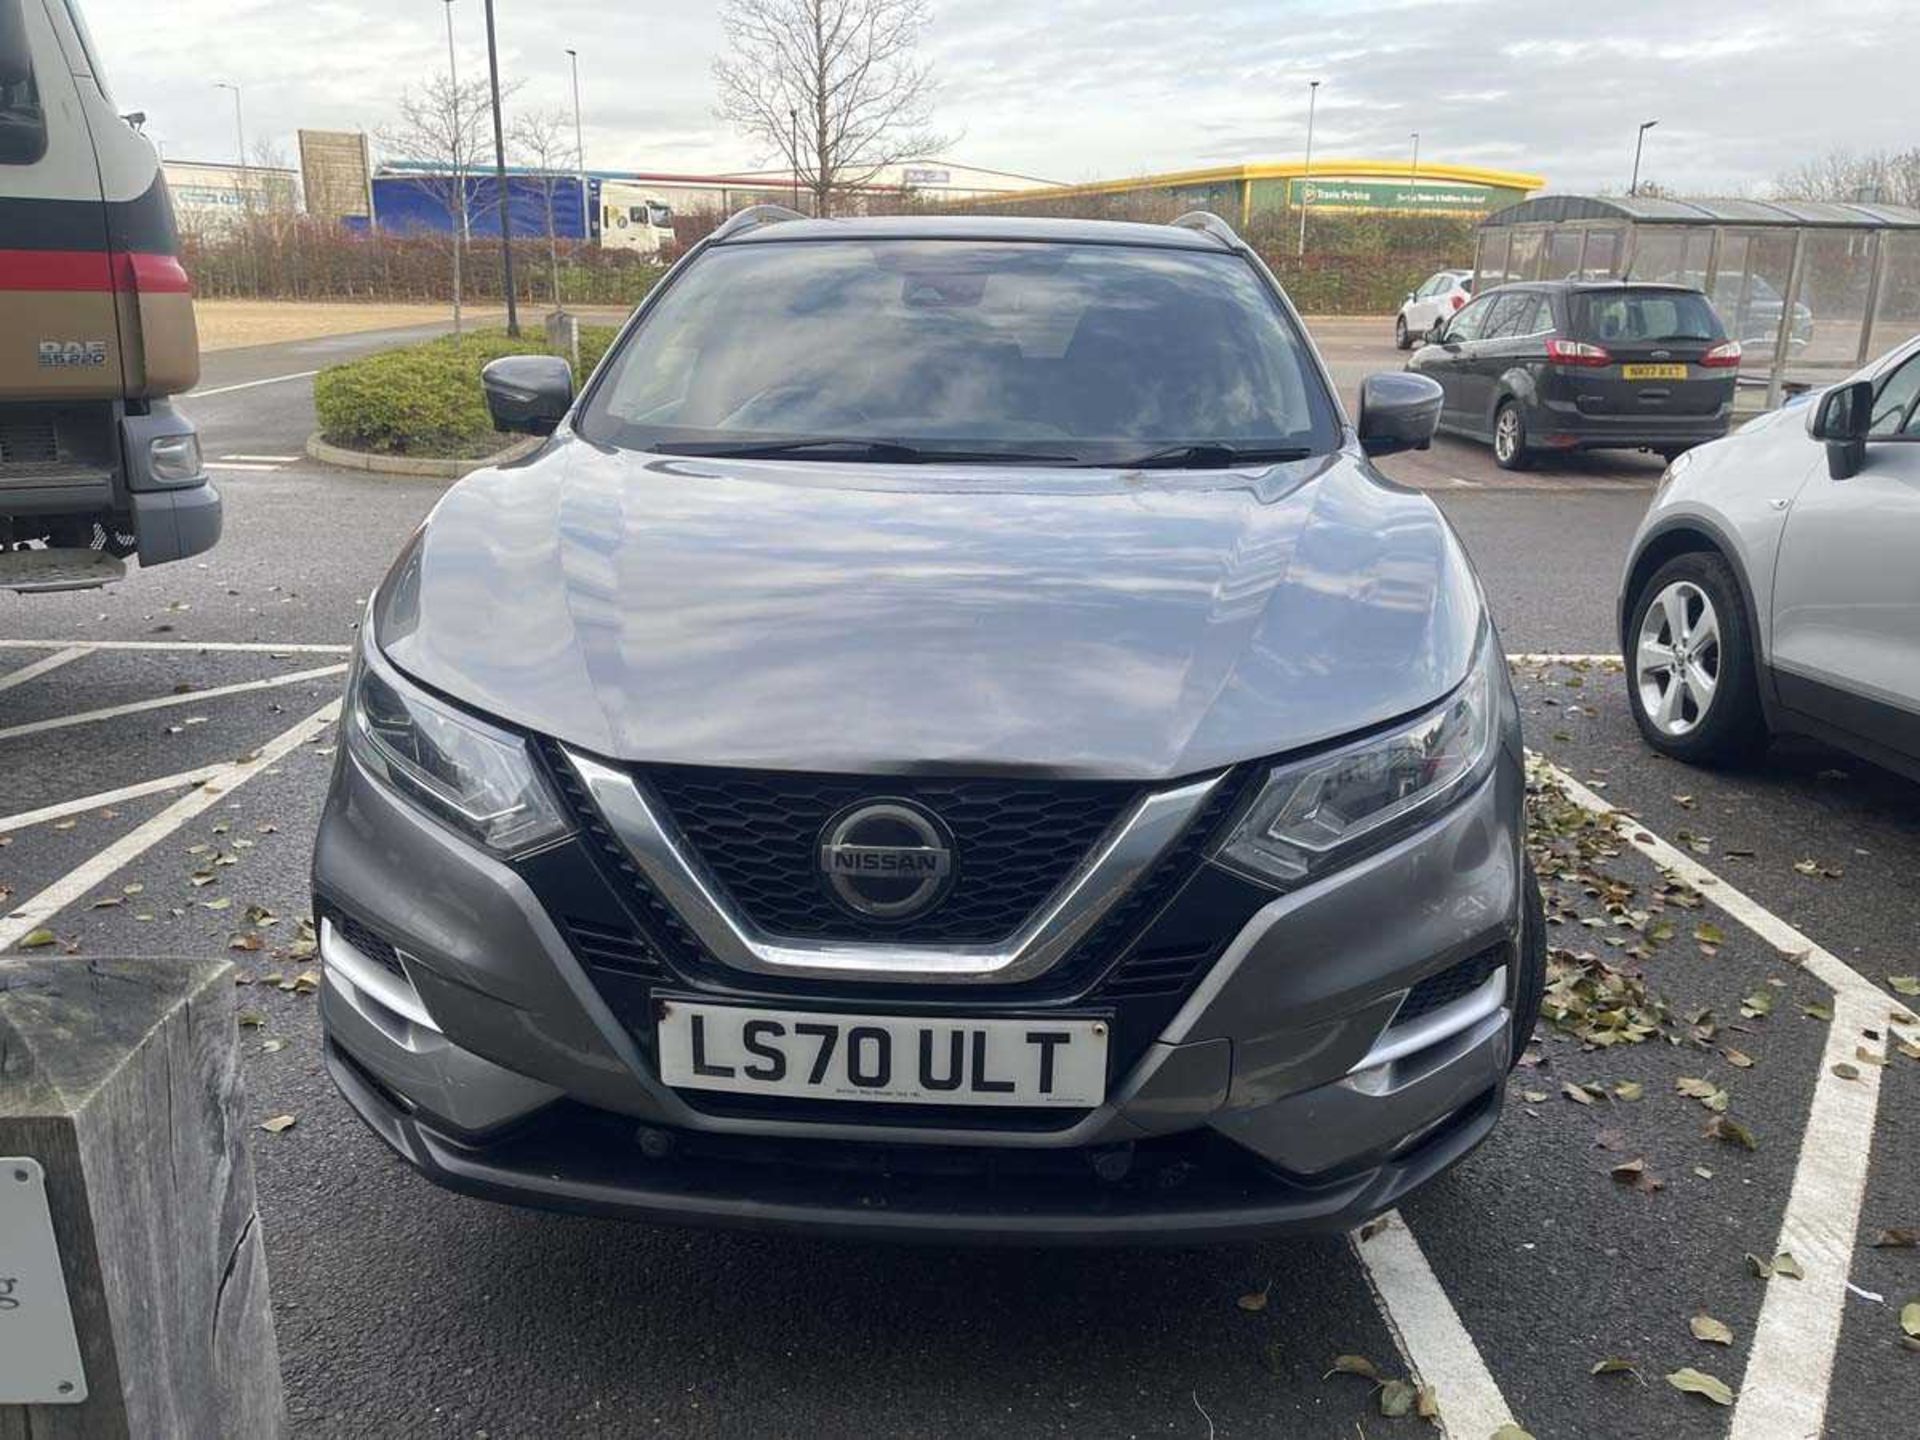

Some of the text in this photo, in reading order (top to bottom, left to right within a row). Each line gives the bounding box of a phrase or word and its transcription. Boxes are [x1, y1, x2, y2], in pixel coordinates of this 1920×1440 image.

[834, 851, 937, 872] NISSAN
[690, 1013, 1072, 1095] LS70 ULT
